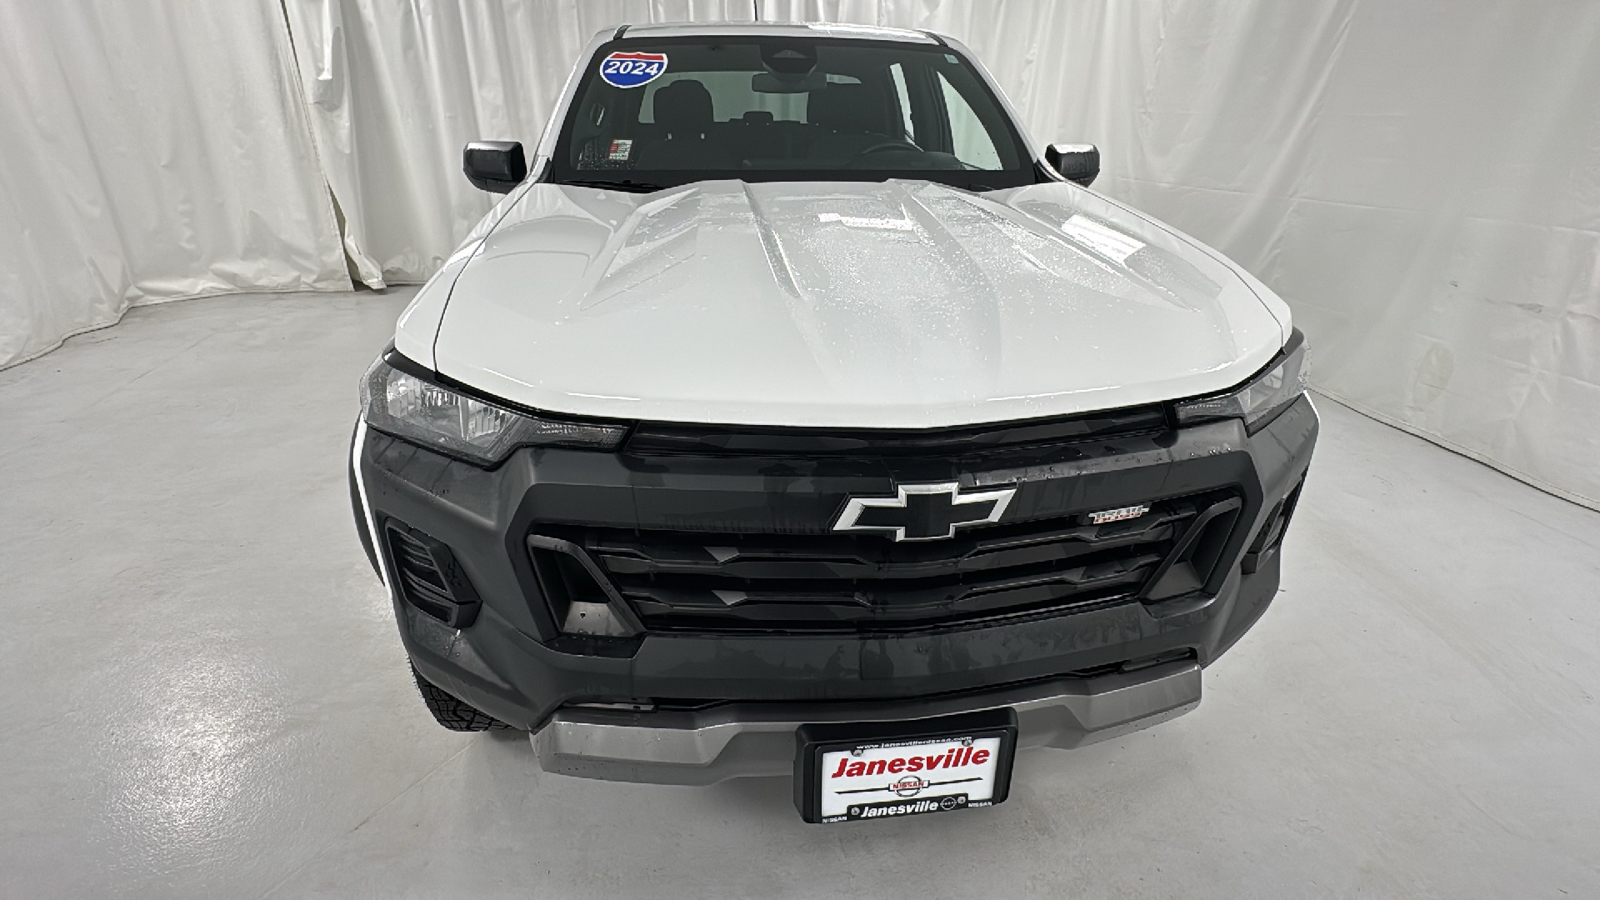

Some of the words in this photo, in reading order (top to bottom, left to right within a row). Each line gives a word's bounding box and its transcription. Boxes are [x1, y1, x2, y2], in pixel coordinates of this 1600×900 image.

[604, 61, 660, 76] 2024
[831, 746, 991, 779] Janesville
[892, 780, 925, 790] NISSAN
[860, 800, 938, 818] Janesville
